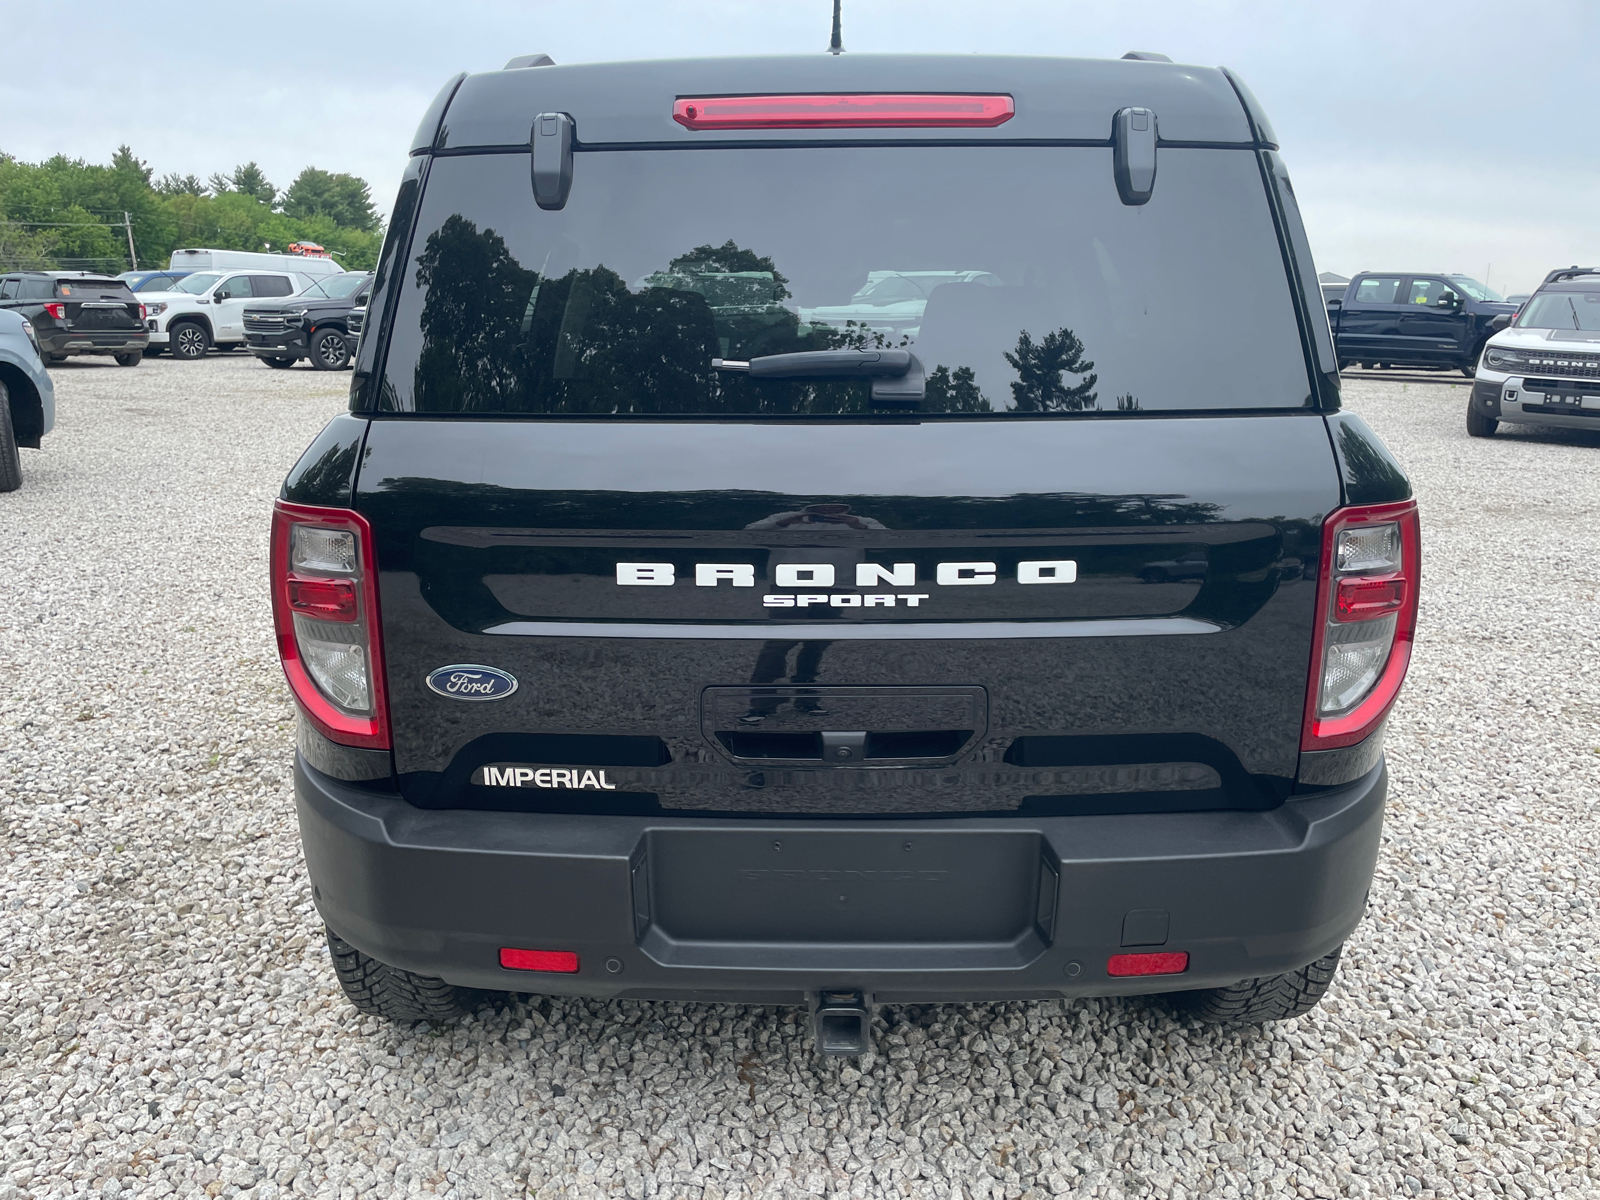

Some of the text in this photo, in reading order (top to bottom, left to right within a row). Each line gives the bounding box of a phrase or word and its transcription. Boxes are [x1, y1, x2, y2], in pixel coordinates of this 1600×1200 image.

[616, 560, 1077, 587] BRONCO
[763, 594, 929, 607] SPORT
[446, 672, 494, 694] Ford
[483, 767, 616, 789] IMPERIAL
